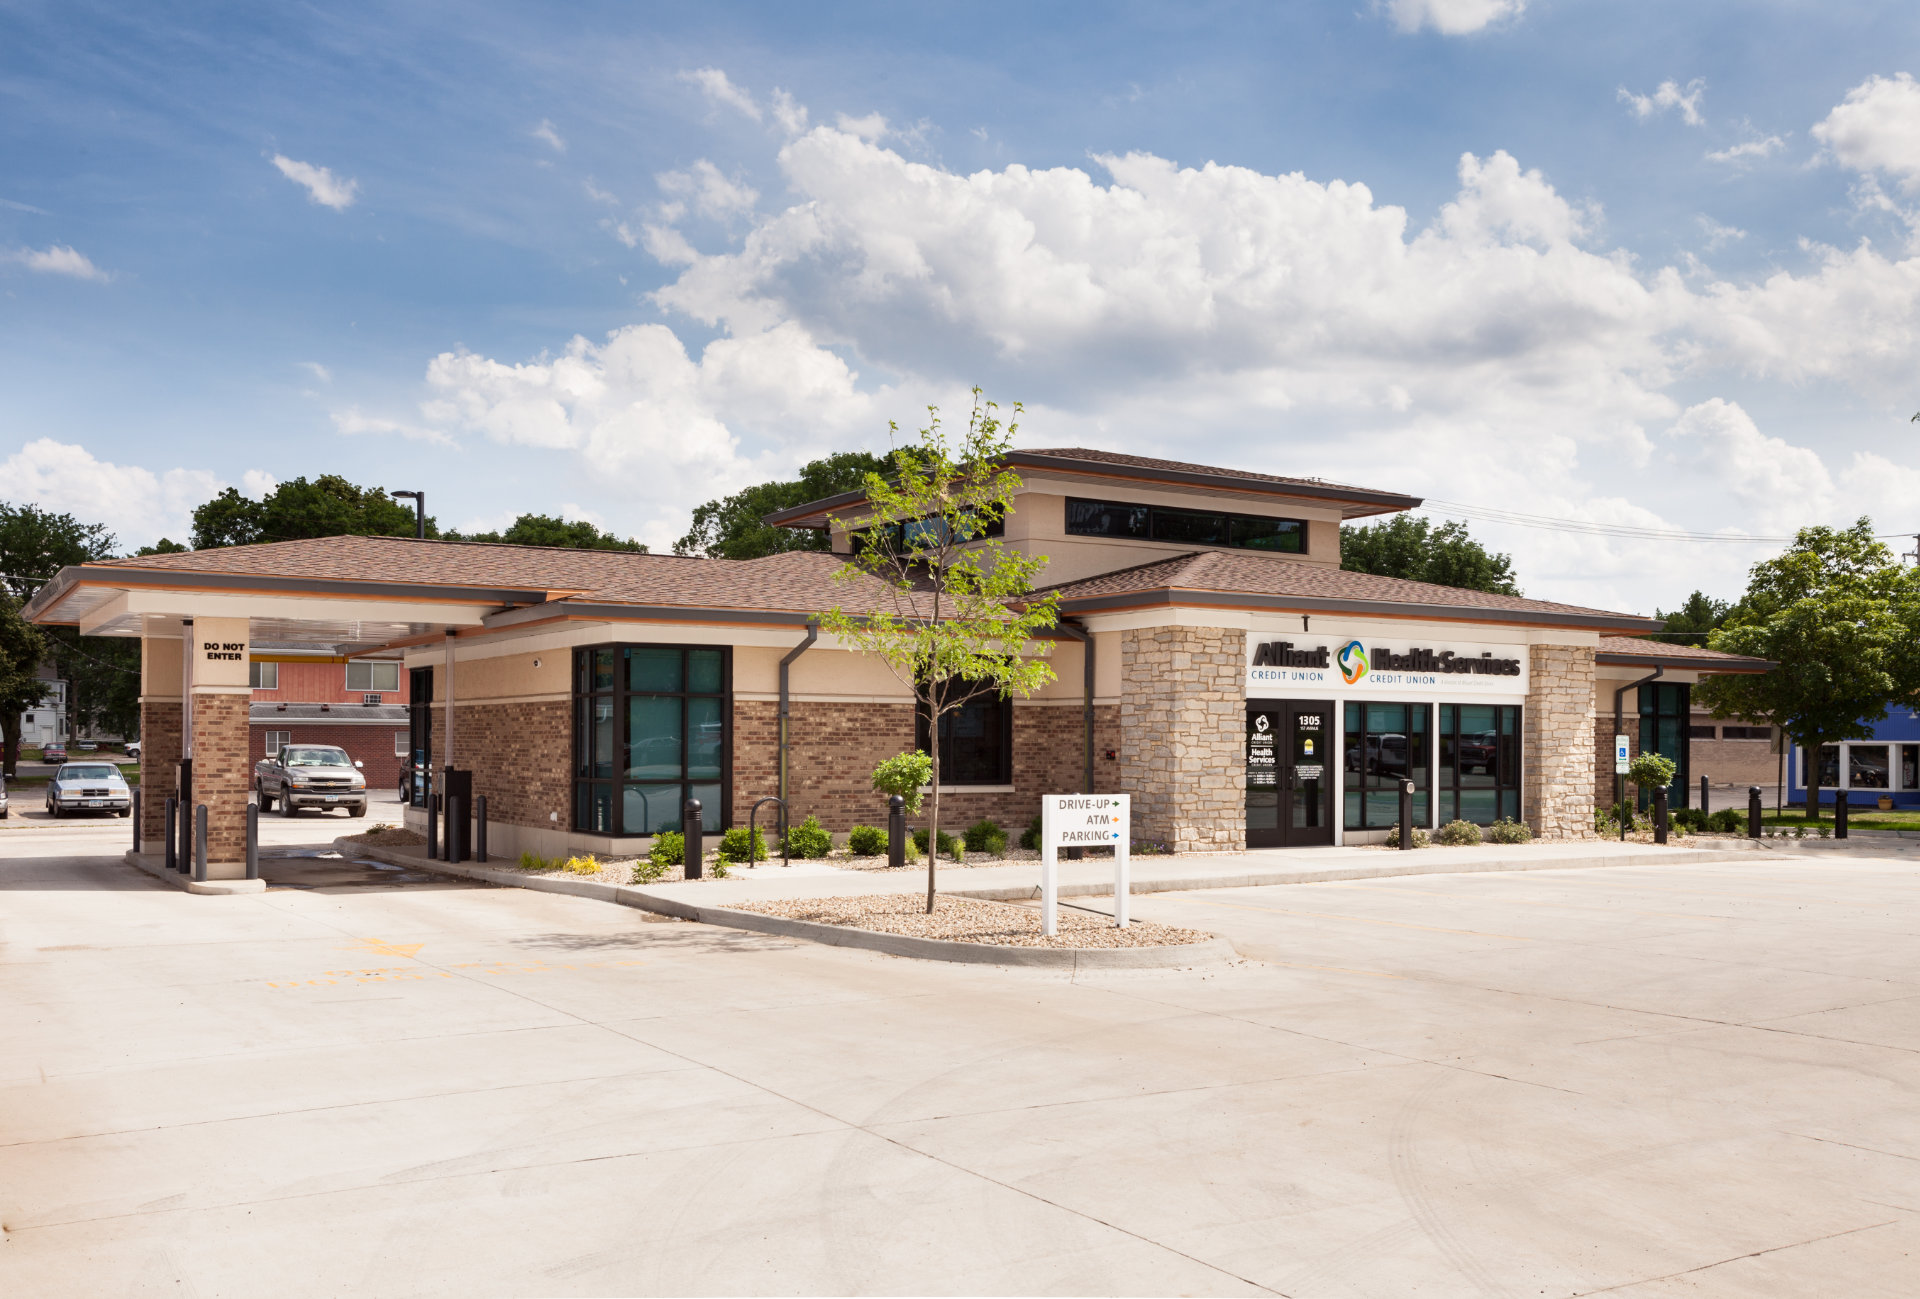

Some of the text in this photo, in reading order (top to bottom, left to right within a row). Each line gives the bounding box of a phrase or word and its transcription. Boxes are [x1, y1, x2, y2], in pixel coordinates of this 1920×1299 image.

[204, 642, 245, 651] DO NOT
[207, 652, 242, 660] ENTER
[1252, 641, 1330, 669] Alliant
[1370, 648, 1520, 676] Health Services
[1251, 670, 1324, 681] CREDIT UNION
[1369, 674, 1402, 683] CREDIT
[1406, 675, 1436, 685] UNION
[1299, 715, 1320, 726] 1305
[1251, 733, 1273, 741] Alliant
[1251, 748, 1273, 756] Health
[1248, 756, 1276, 764] Services
[1059, 799, 1110, 810] DRIVE-UP
[1086, 815, 1110, 825] ATM
[1062, 830, 1110, 841] PARKING
